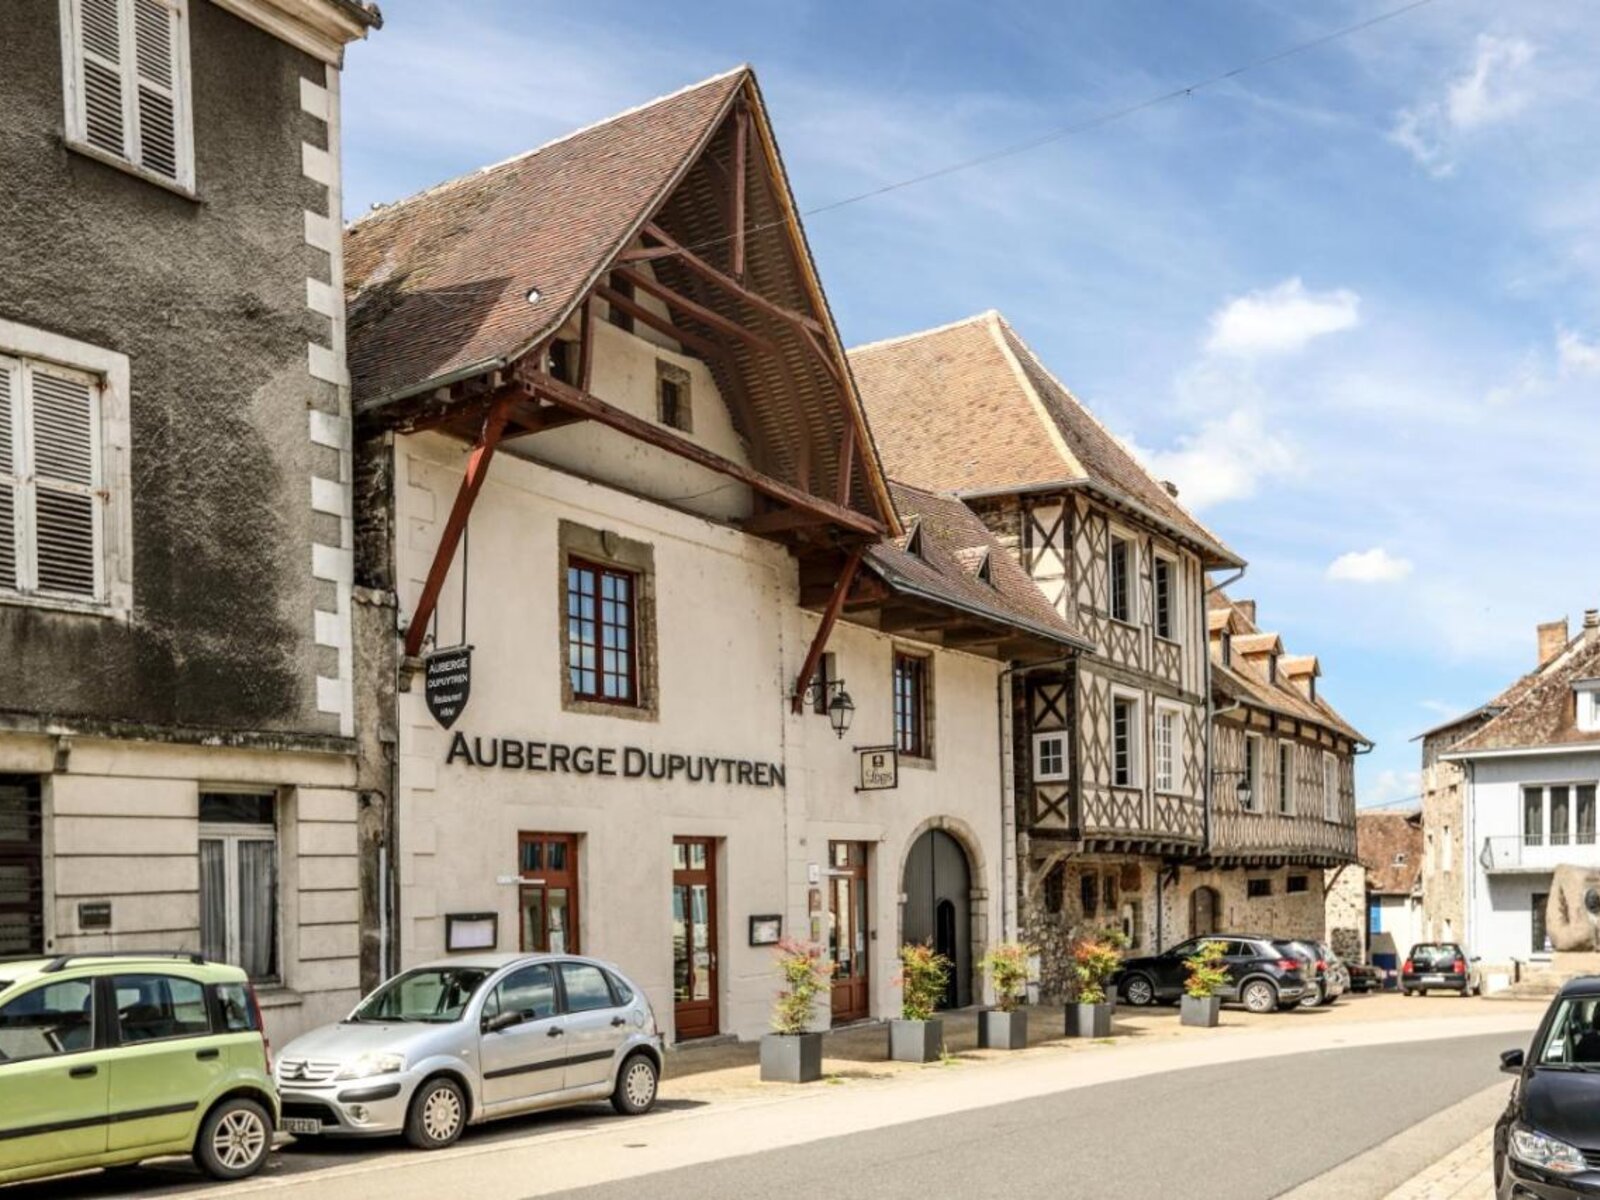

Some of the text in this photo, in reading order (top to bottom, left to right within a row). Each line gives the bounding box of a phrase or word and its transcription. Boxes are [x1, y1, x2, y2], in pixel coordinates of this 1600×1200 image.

[428, 657, 468, 674] AUBERGE
[427, 673, 468, 689] DUPUYTREN
[446, 730, 786, 789] AUBERGE DUPUYTREN
